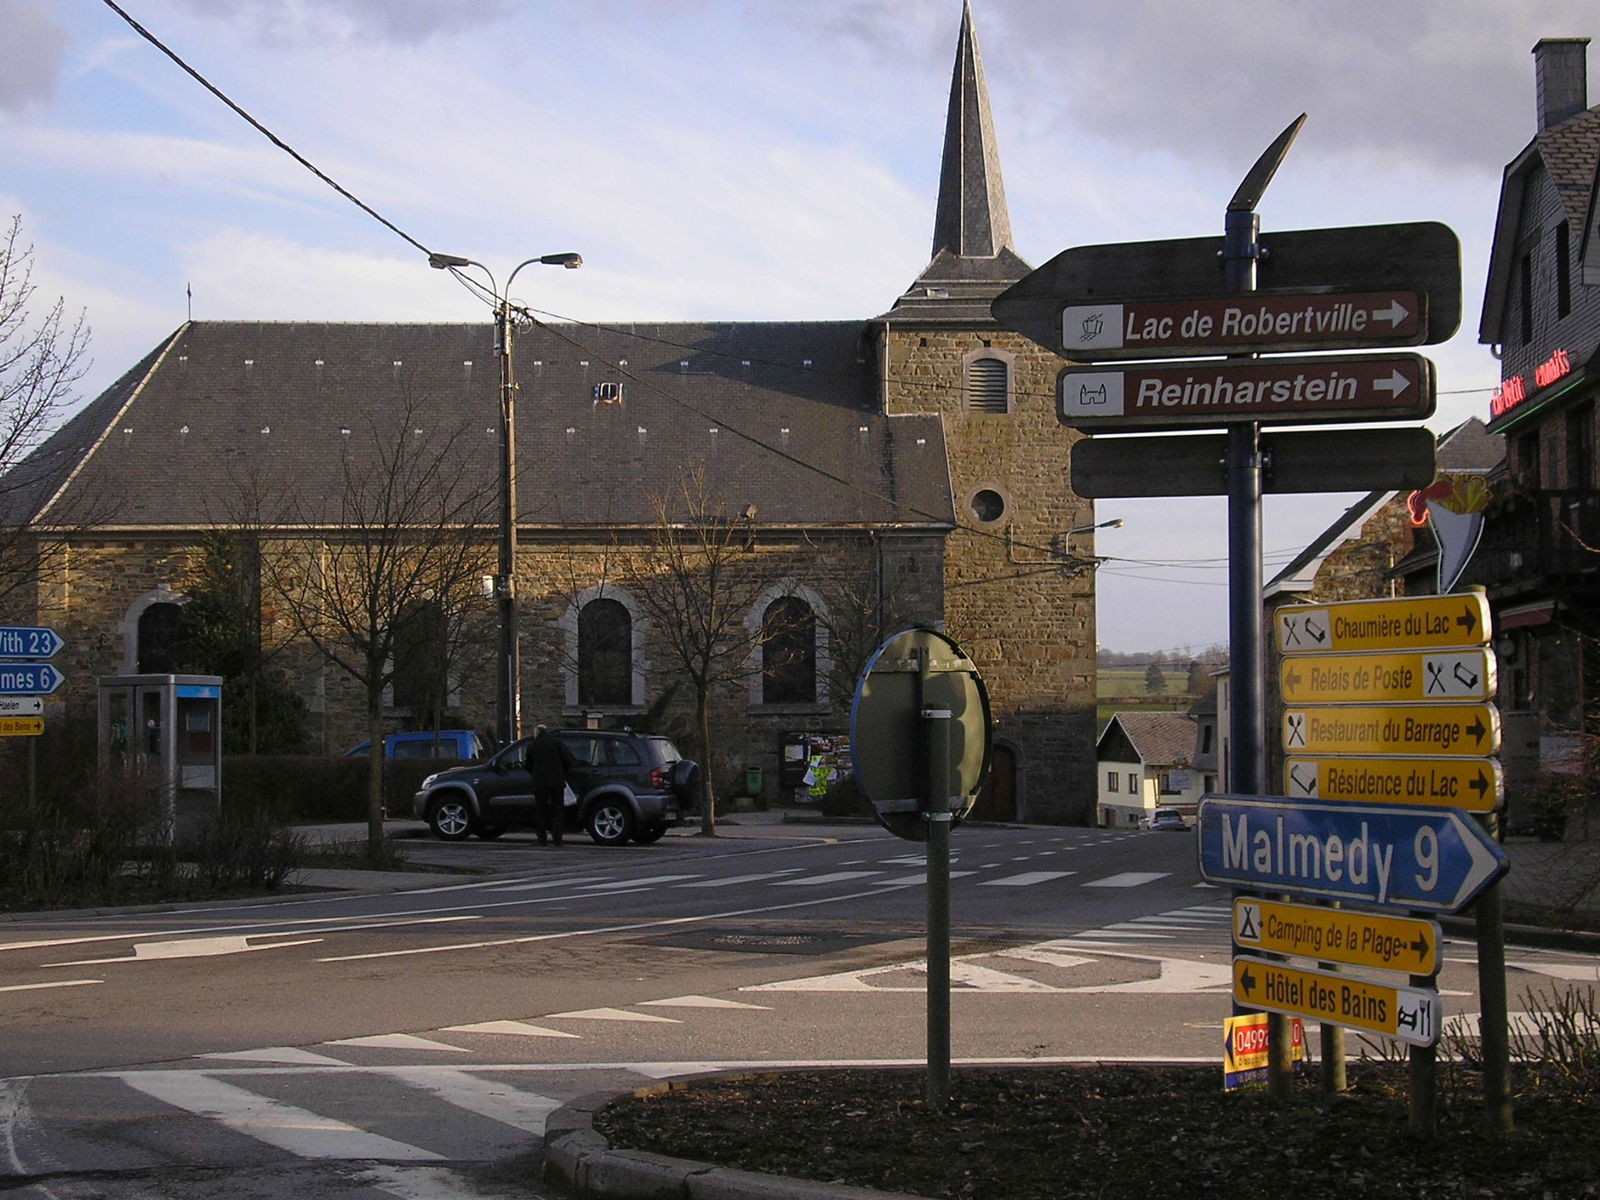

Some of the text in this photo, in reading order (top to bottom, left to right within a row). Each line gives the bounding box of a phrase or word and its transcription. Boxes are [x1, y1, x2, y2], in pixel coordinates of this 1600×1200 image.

[1126, 303, 1369, 340] Lac de Robertville
[1136, 371, 1358, 407] Reinharstein
[1335, 612, 1450, 640] Chaumière du Lac
[29, 632, 51, 653] 23
[40, 668, 50, 689] 6
[1310, 665, 1413, 692] Relais de Poste
[1310, 717, 1459, 749] Restaurant du Barrage
[1328, 768, 1458, 798] Résidence du Lac
[1221, 813, 1439, 904] Malmedy 9
[1268, 914, 1401, 962] Camping de la Plage
[1266, 972, 1387, 1024] Hôtel des Bains
